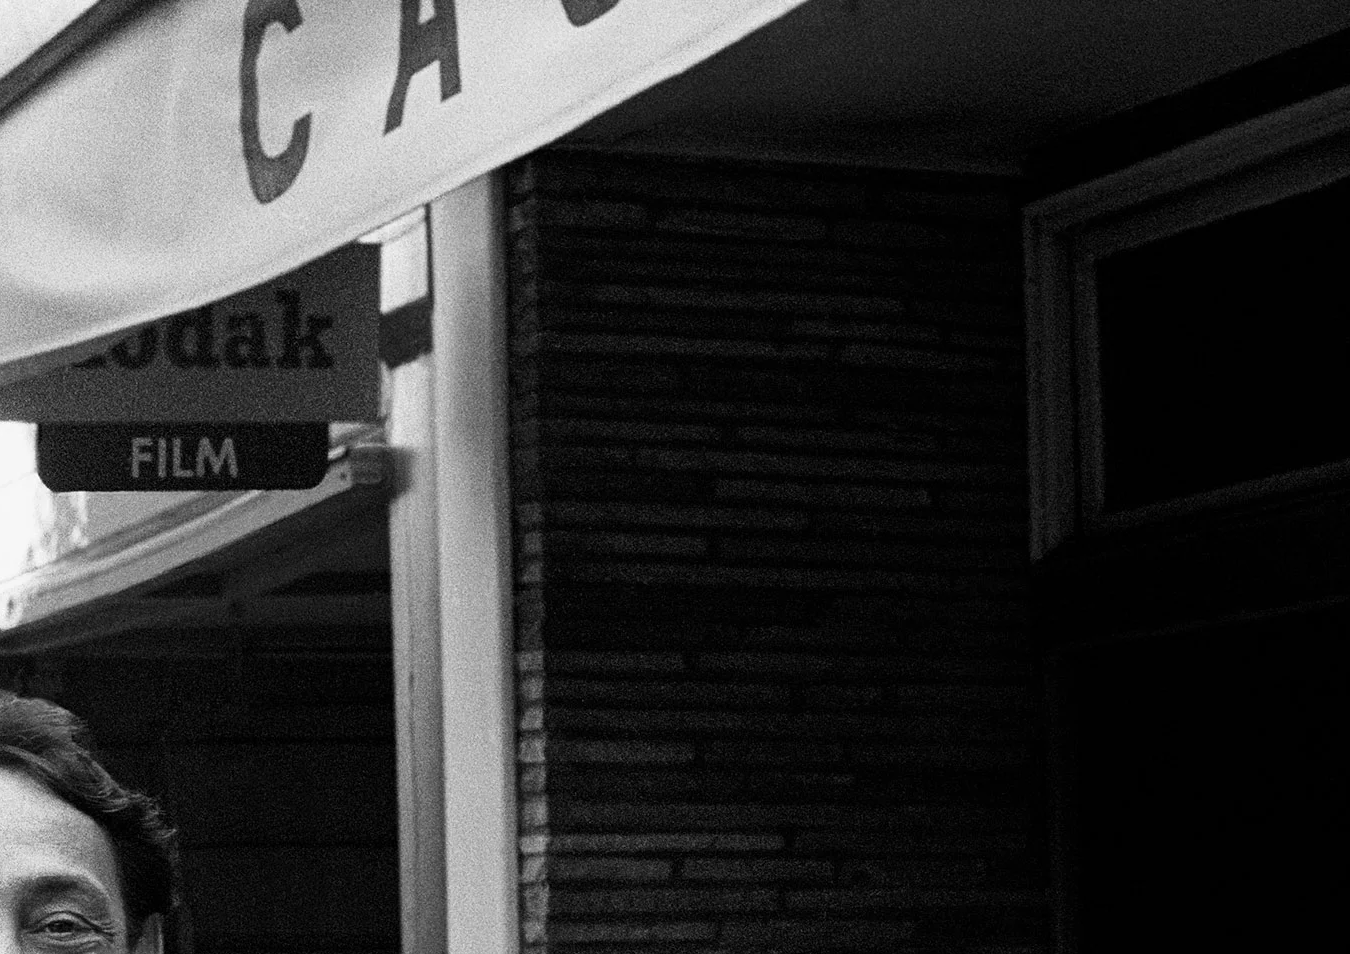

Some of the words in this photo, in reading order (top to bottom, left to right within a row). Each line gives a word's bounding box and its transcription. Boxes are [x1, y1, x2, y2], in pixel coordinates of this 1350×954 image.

[241, 0, 622, 204] CA
[72, 289, 334, 369] odak
[131, 437, 239, 479] FILM
